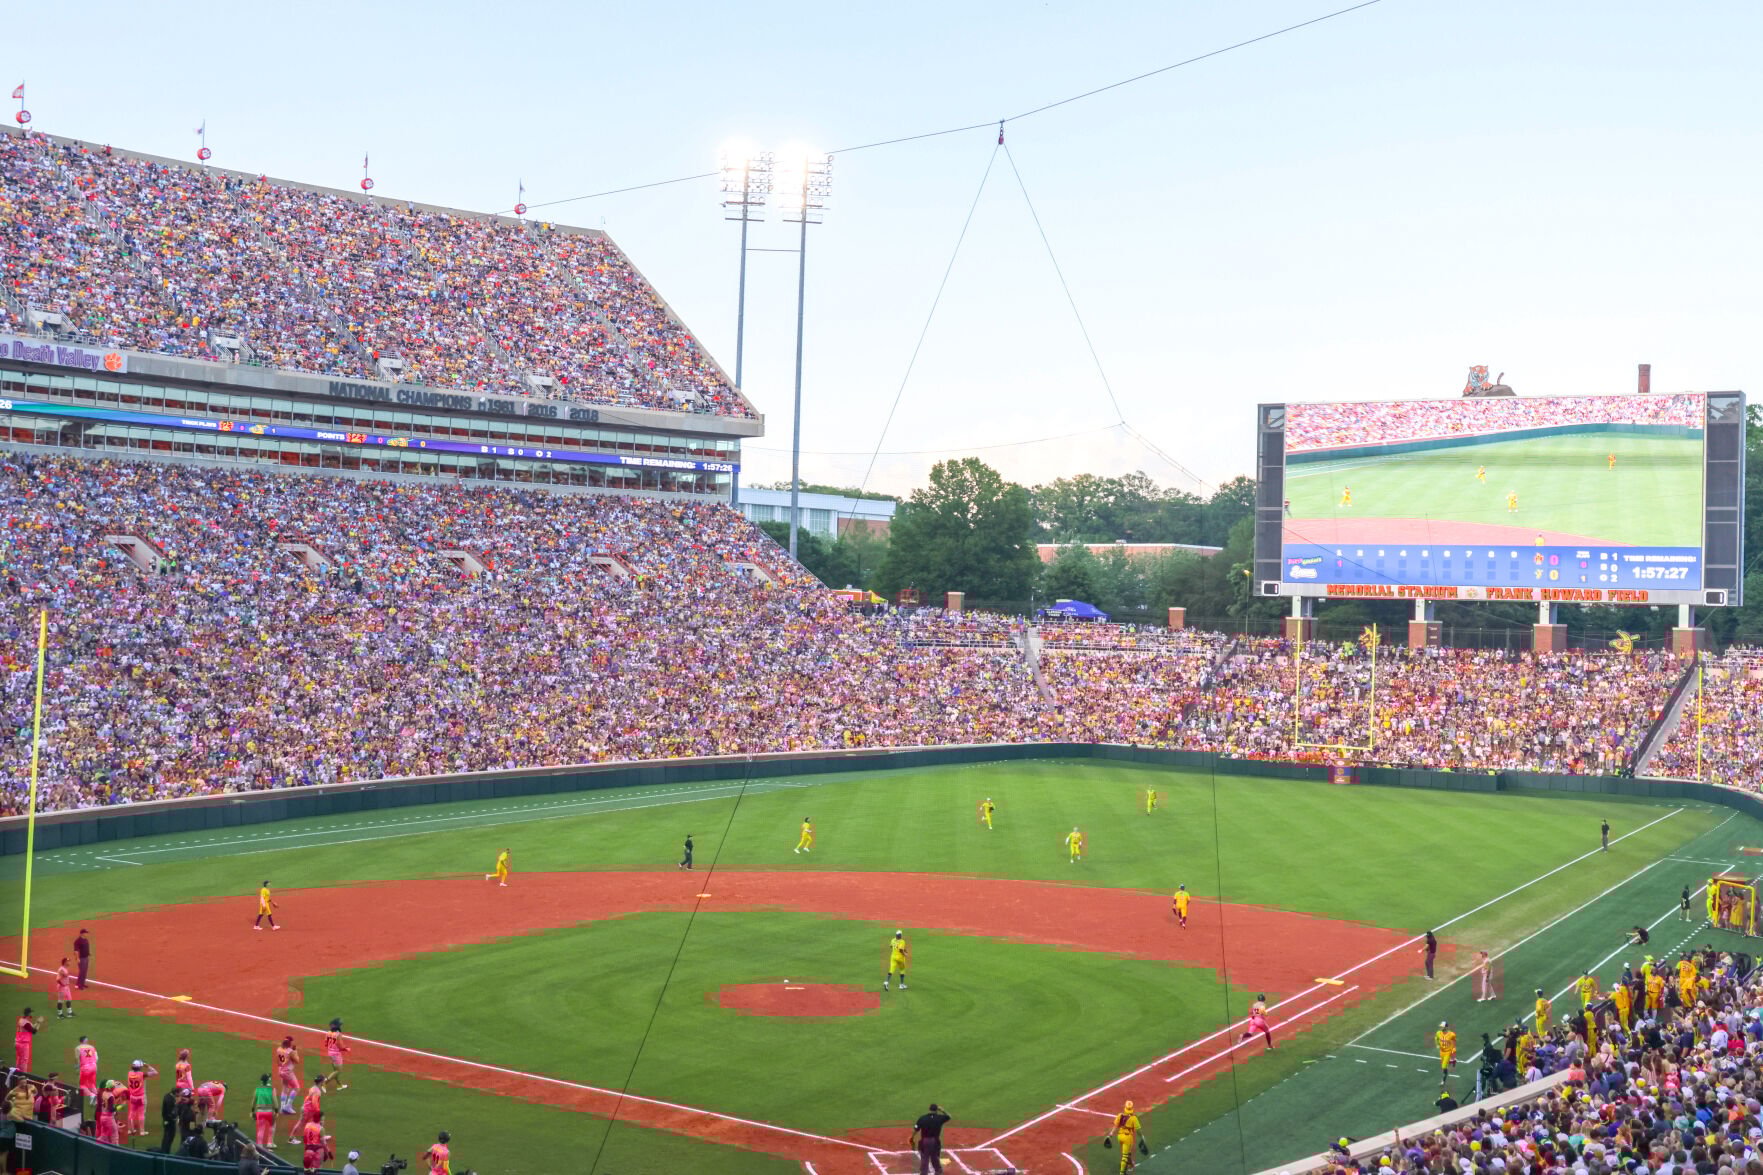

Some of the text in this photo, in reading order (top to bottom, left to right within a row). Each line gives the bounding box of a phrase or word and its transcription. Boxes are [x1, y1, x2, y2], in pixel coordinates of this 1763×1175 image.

[13, 340, 55, 363] Death
[57, 345, 100, 372] Valley
[329, 381, 473, 410] NATIONAL CHAMPIONS
[488, 399, 516, 415] 1981
[528, 403, 558, 418] 2016
[570, 407, 599, 422] 2018
[317, 431, 346, 441] POINTS
[620, 456, 696, 470] TIME REMAINING:
[702, 462, 733, 472] 1:57:26
[1465, 550, 1473, 558] 7
[1612, 552, 1618, 561] 1
[1610, 574, 1618, 582] 2
[1632, 566, 1688, 579] 1:57:27
[1327, 584, 1458, 598] MEMORIAL STADIUM
[1486, 588, 1649, 602] FRANK HOWARD FIELD
